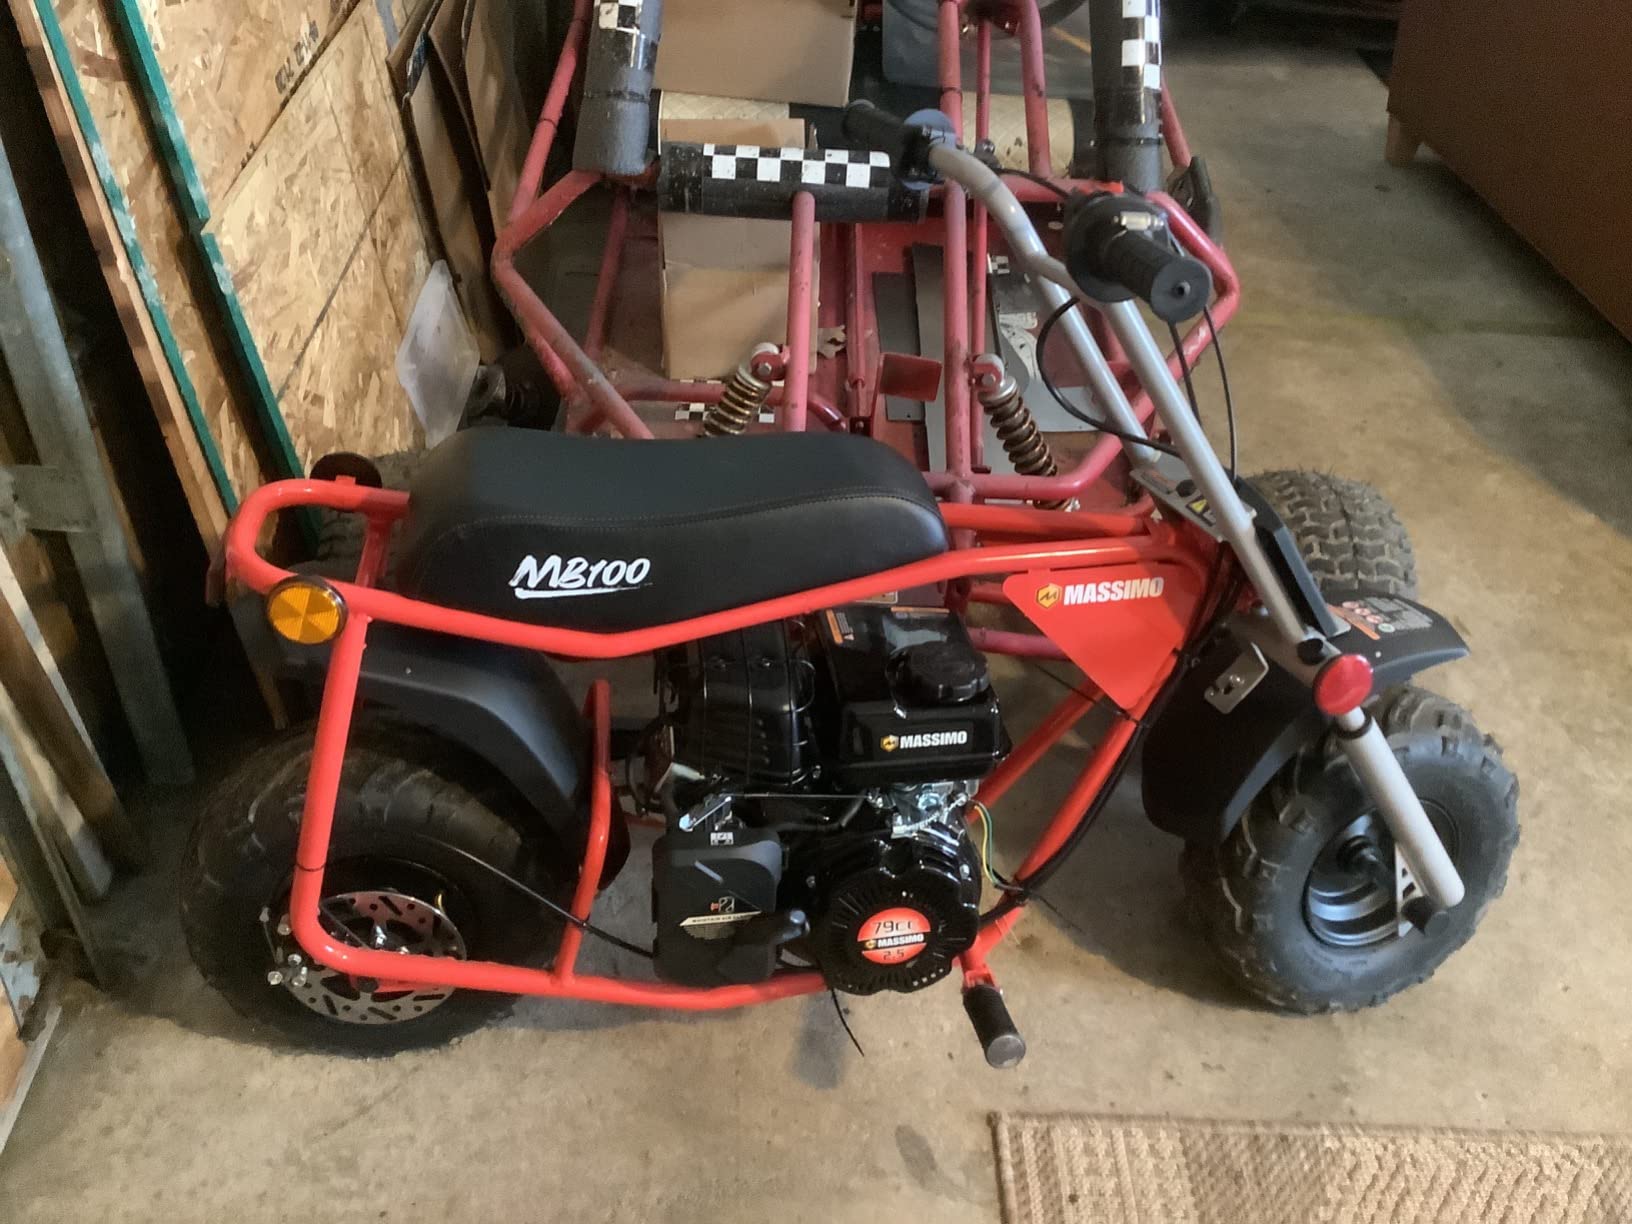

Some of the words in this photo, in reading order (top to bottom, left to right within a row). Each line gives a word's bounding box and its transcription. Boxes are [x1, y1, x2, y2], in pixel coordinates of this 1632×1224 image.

[508, 554, 651, 590] MB100
[1063, 576, 1165, 606] MASSIMO
[899, 730, 968, 749] MASSIMO
[877, 933, 925, 948] MASSIMO
